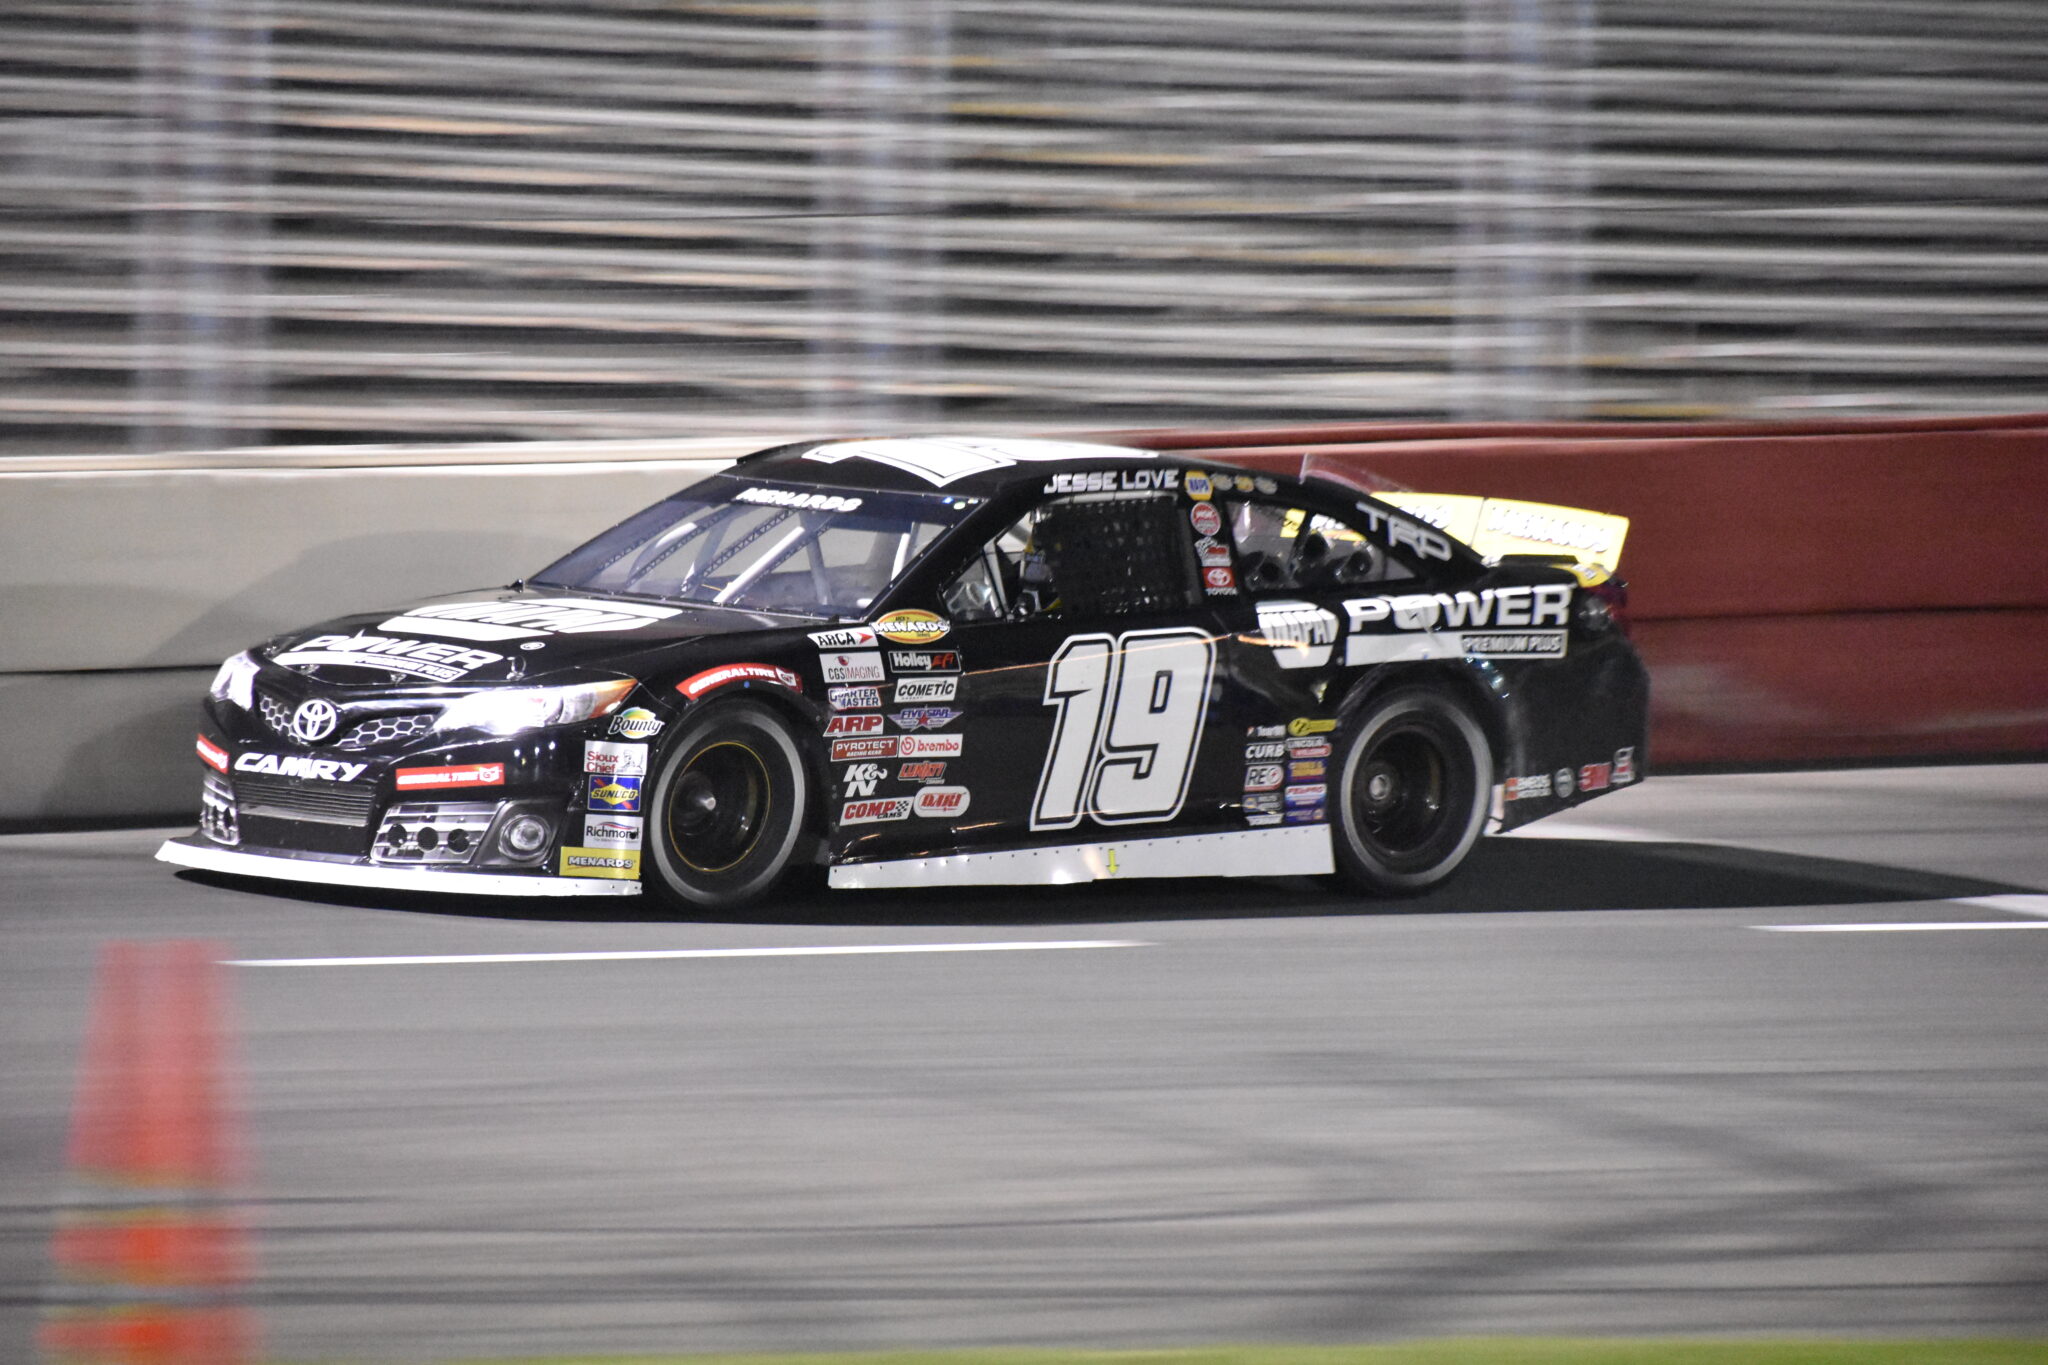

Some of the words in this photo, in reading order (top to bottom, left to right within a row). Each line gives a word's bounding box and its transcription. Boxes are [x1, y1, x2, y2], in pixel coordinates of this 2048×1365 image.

[1044, 472, 1118, 494] JESSE
[1121, 469, 1179, 491] LOVE
[1356, 501, 1453, 562] TRD
[1342, 584, 1573, 632] POWER
[871, 620, 950, 635] MENARDS
[817, 632, 857, 646] ARCA
[1529, 635, 1561, 652] PLUS
[290, 630, 504, 670] POWER
[893, 652, 931, 670] Holley
[608, 714, 665, 736] Bounty
[826, 715, 883, 733] ARP
[1029, 626, 1218, 832] 19
[836, 739, 894, 752] PYROTECT
[918, 738, 959, 752] brembo
[1245, 744, 1285, 759] CURB
[586, 750, 619, 763] Sioux
[234, 752, 367, 782] CAMRY
[586, 761, 617, 773] Chief
[844, 800, 897, 820] COMP
[877, 811, 903, 820] CAMS
[568, 855, 634, 869] MENARDS
